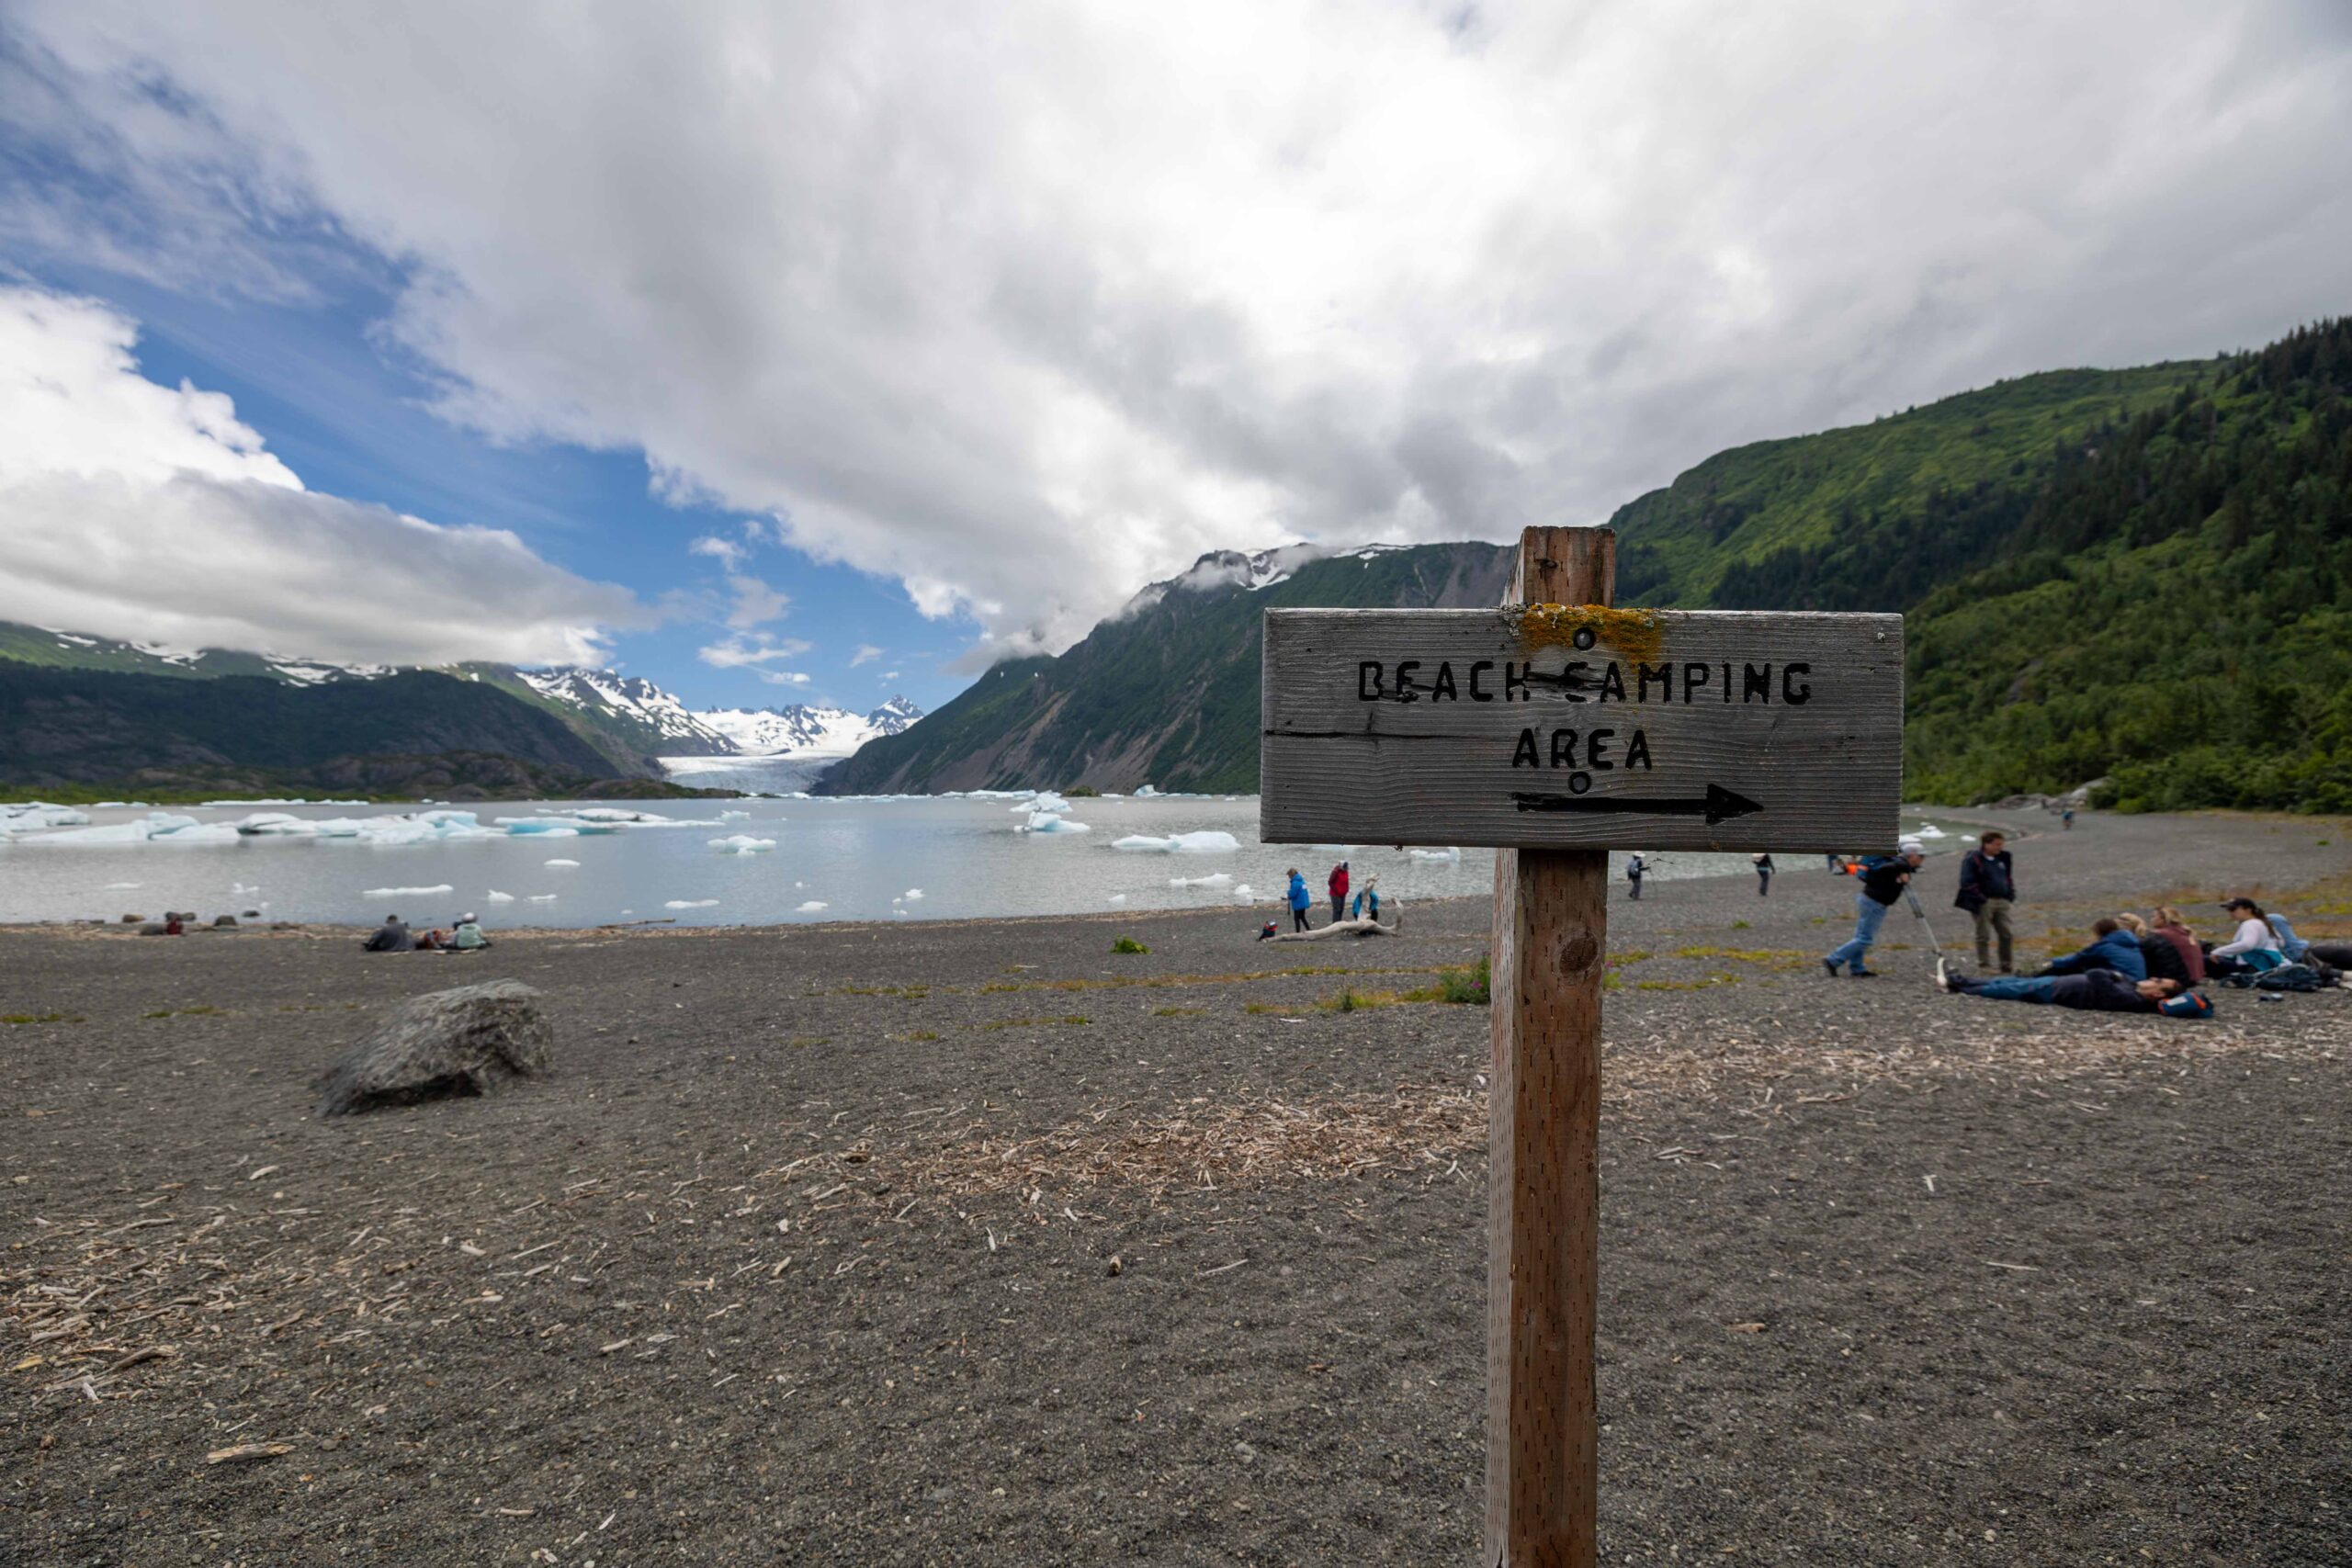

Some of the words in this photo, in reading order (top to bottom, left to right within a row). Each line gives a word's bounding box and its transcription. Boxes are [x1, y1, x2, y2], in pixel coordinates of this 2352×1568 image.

[1358, 660, 1532, 703] BEACH
[1564, 661, 1812, 705] CAMPING
[1511, 728, 1653, 771] AREA
